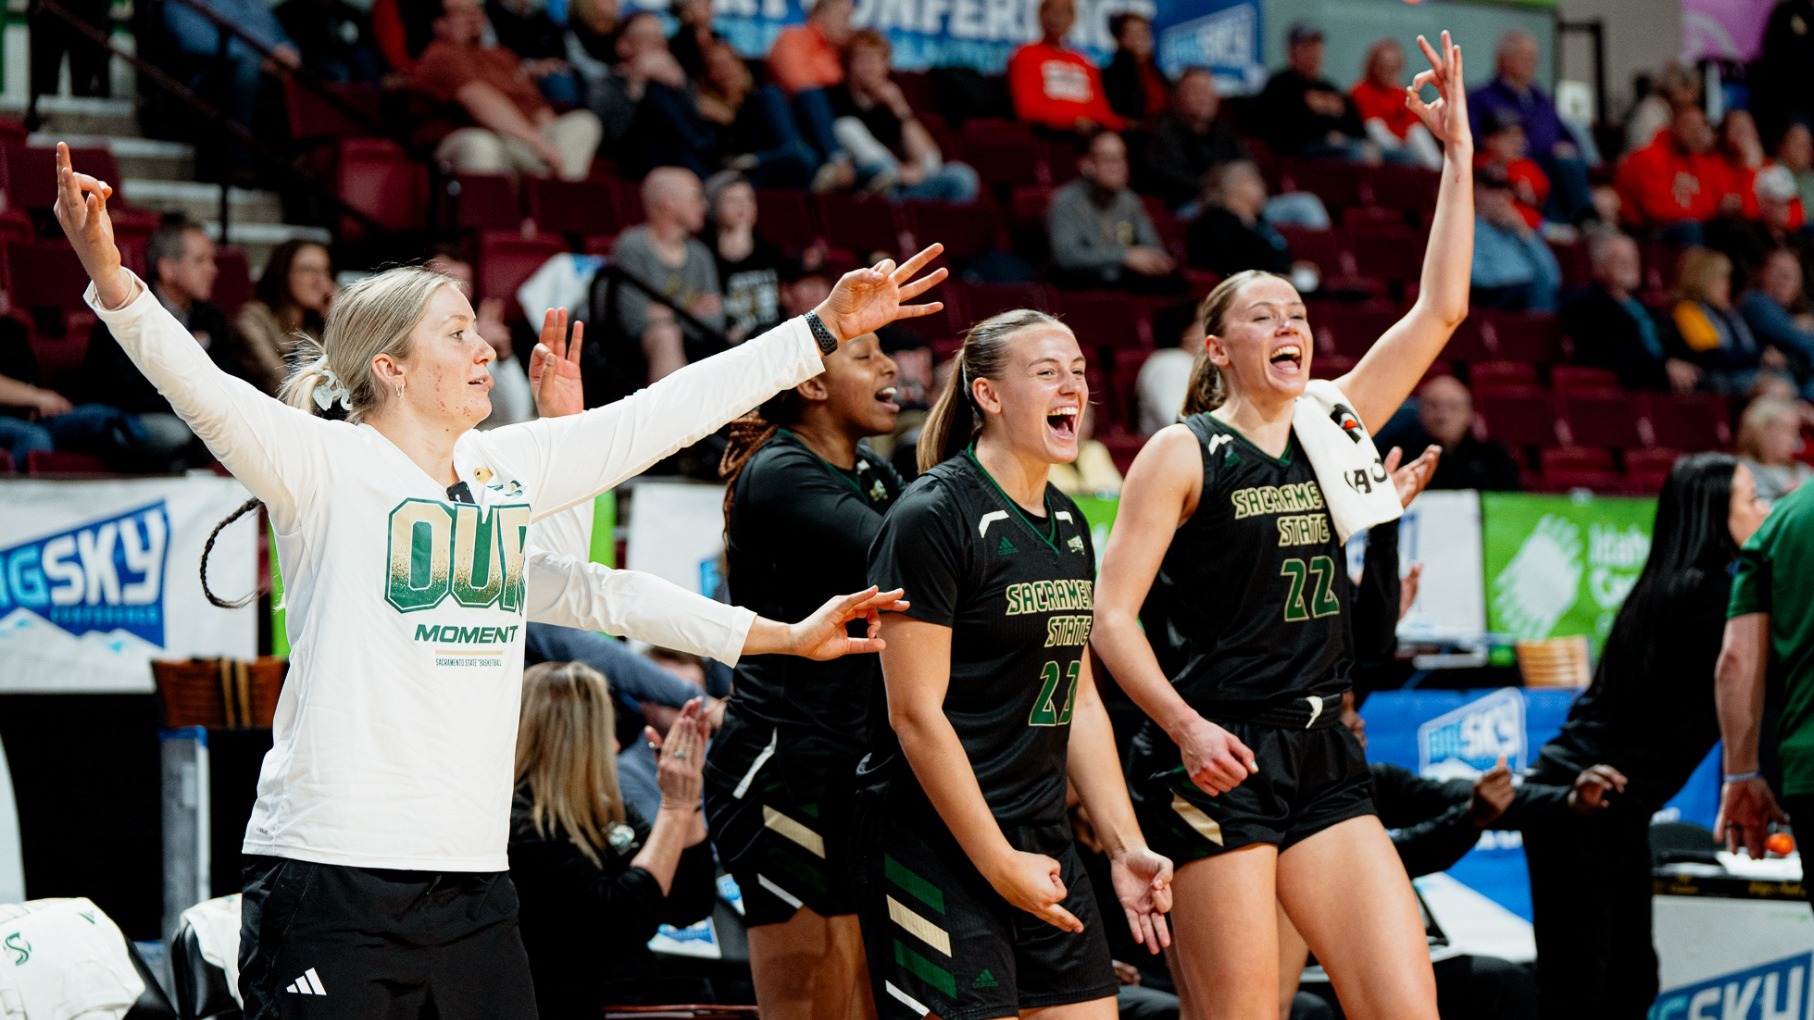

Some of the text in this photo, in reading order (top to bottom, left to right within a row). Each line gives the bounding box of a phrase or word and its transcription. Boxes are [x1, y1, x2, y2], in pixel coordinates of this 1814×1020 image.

[1231, 481, 1326, 520] SACRAME
[1277, 513, 1330, 547] STATE
[384, 498, 532, 614] OUR
[1005, 579, 1094, 615] SACRAMEN
[1280, 555, 1340, 622] 22
[414, 624, 518, 644] MOMENT
[1044, 615, 1093, 647] STATE
